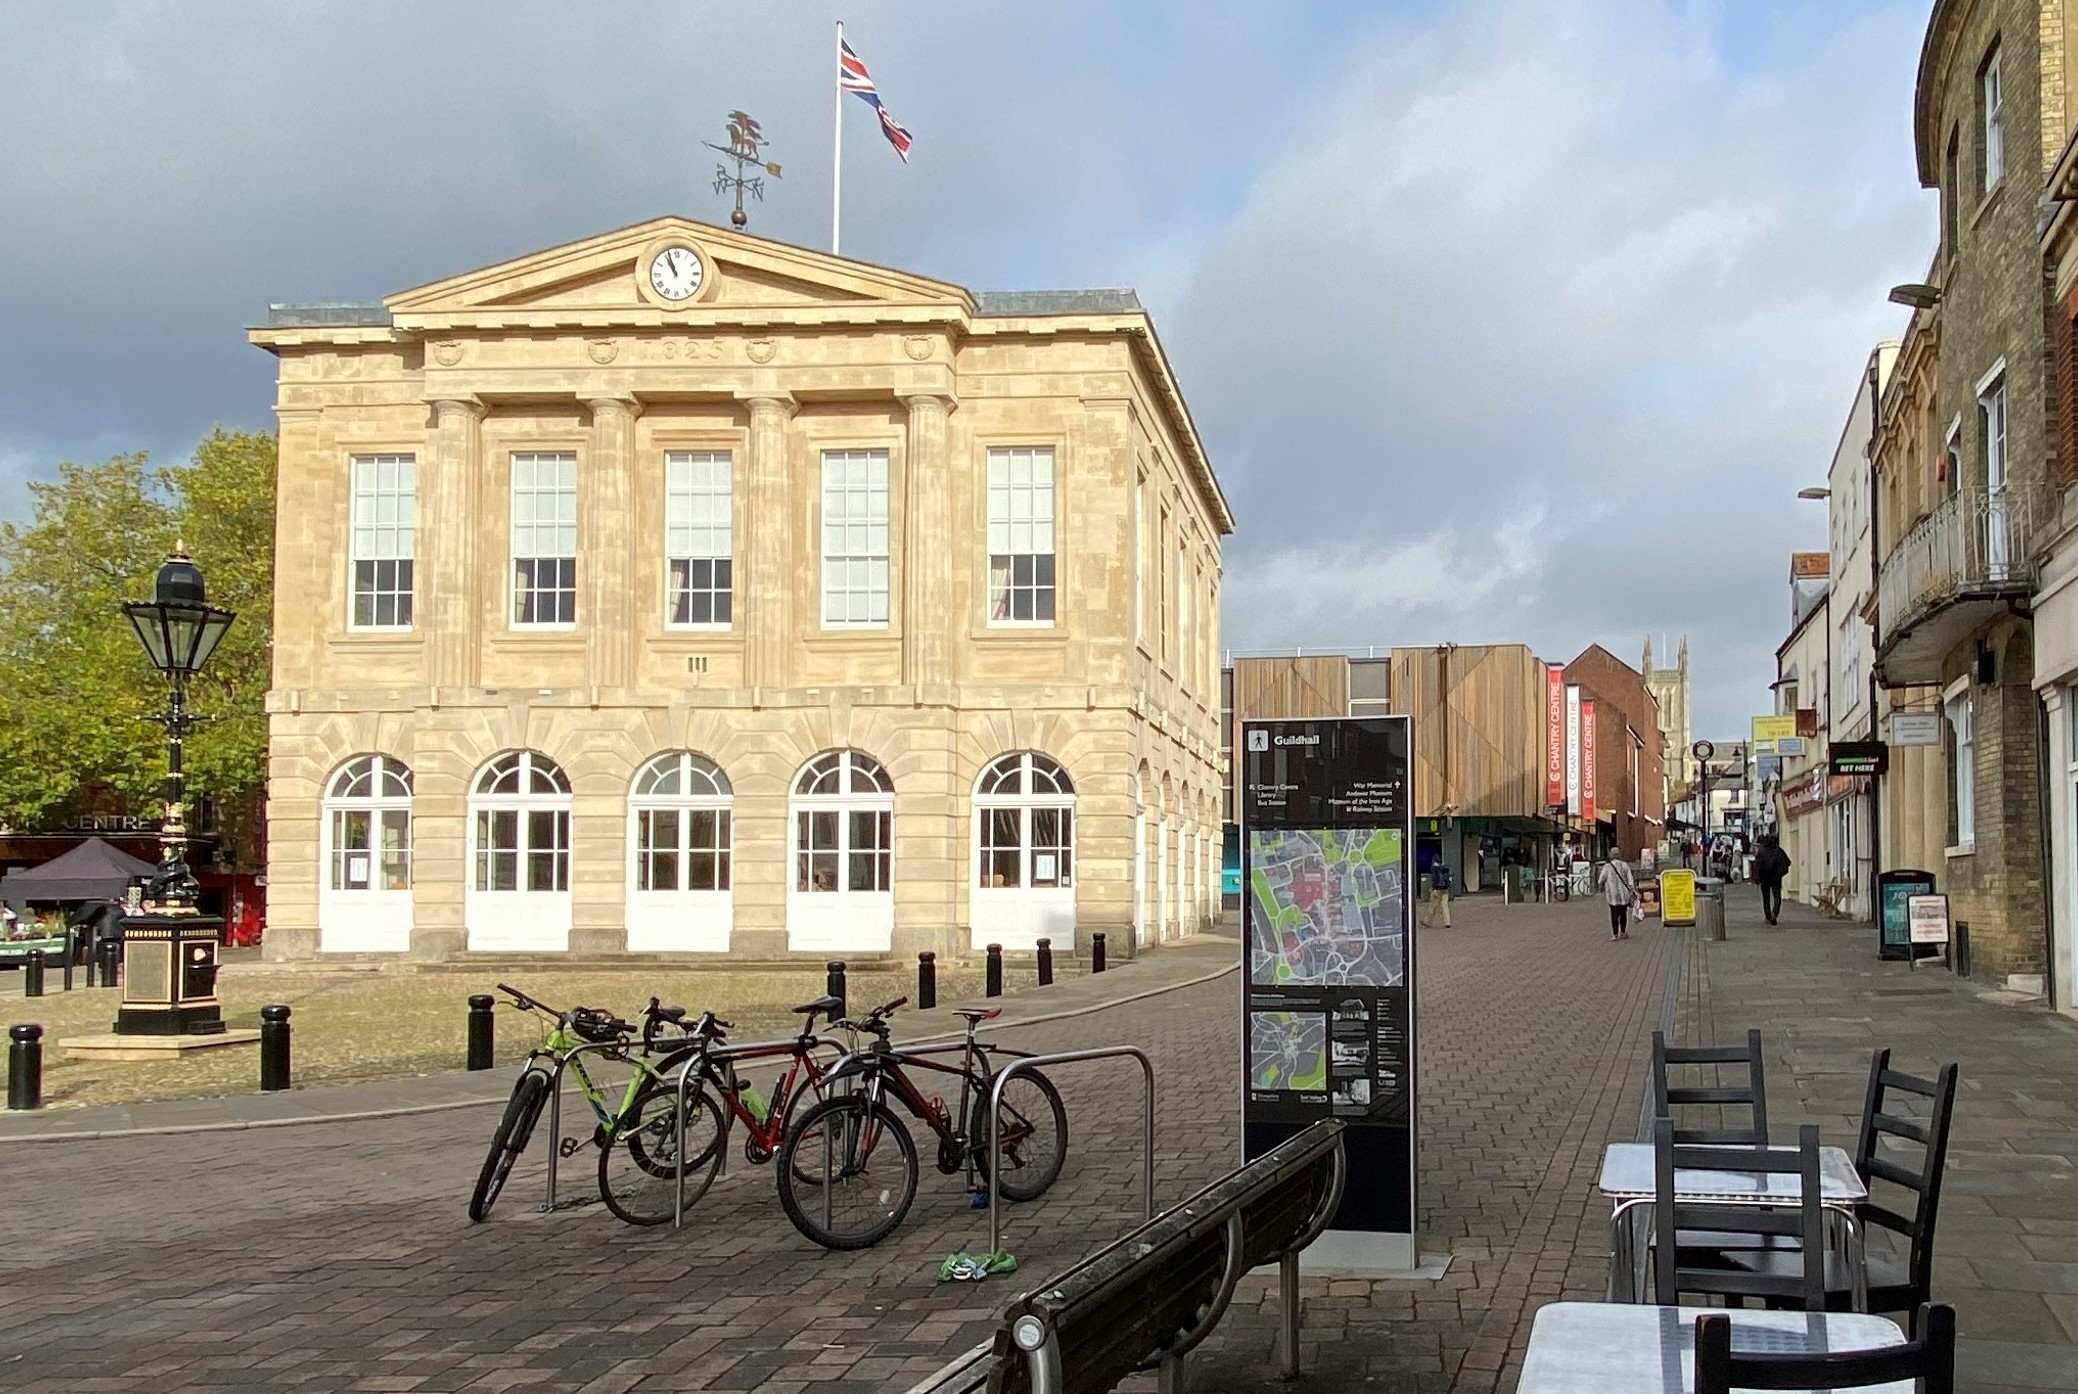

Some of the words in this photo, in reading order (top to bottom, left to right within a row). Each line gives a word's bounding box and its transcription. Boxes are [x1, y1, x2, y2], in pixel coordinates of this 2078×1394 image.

[1551, 682, 1560, 721] CENTRE
[1569, 700, 1577, 736] CENTRE
[1274, 735, 1320, 745] Guildhall
[1551, 723, 1560, 771] CHANTRY
[1584, 713, 1592, 748] CENTRE
[1569, 737, 1577, 780] CHANTRY
[1584, 749, 1592, 789] CHANTRY
